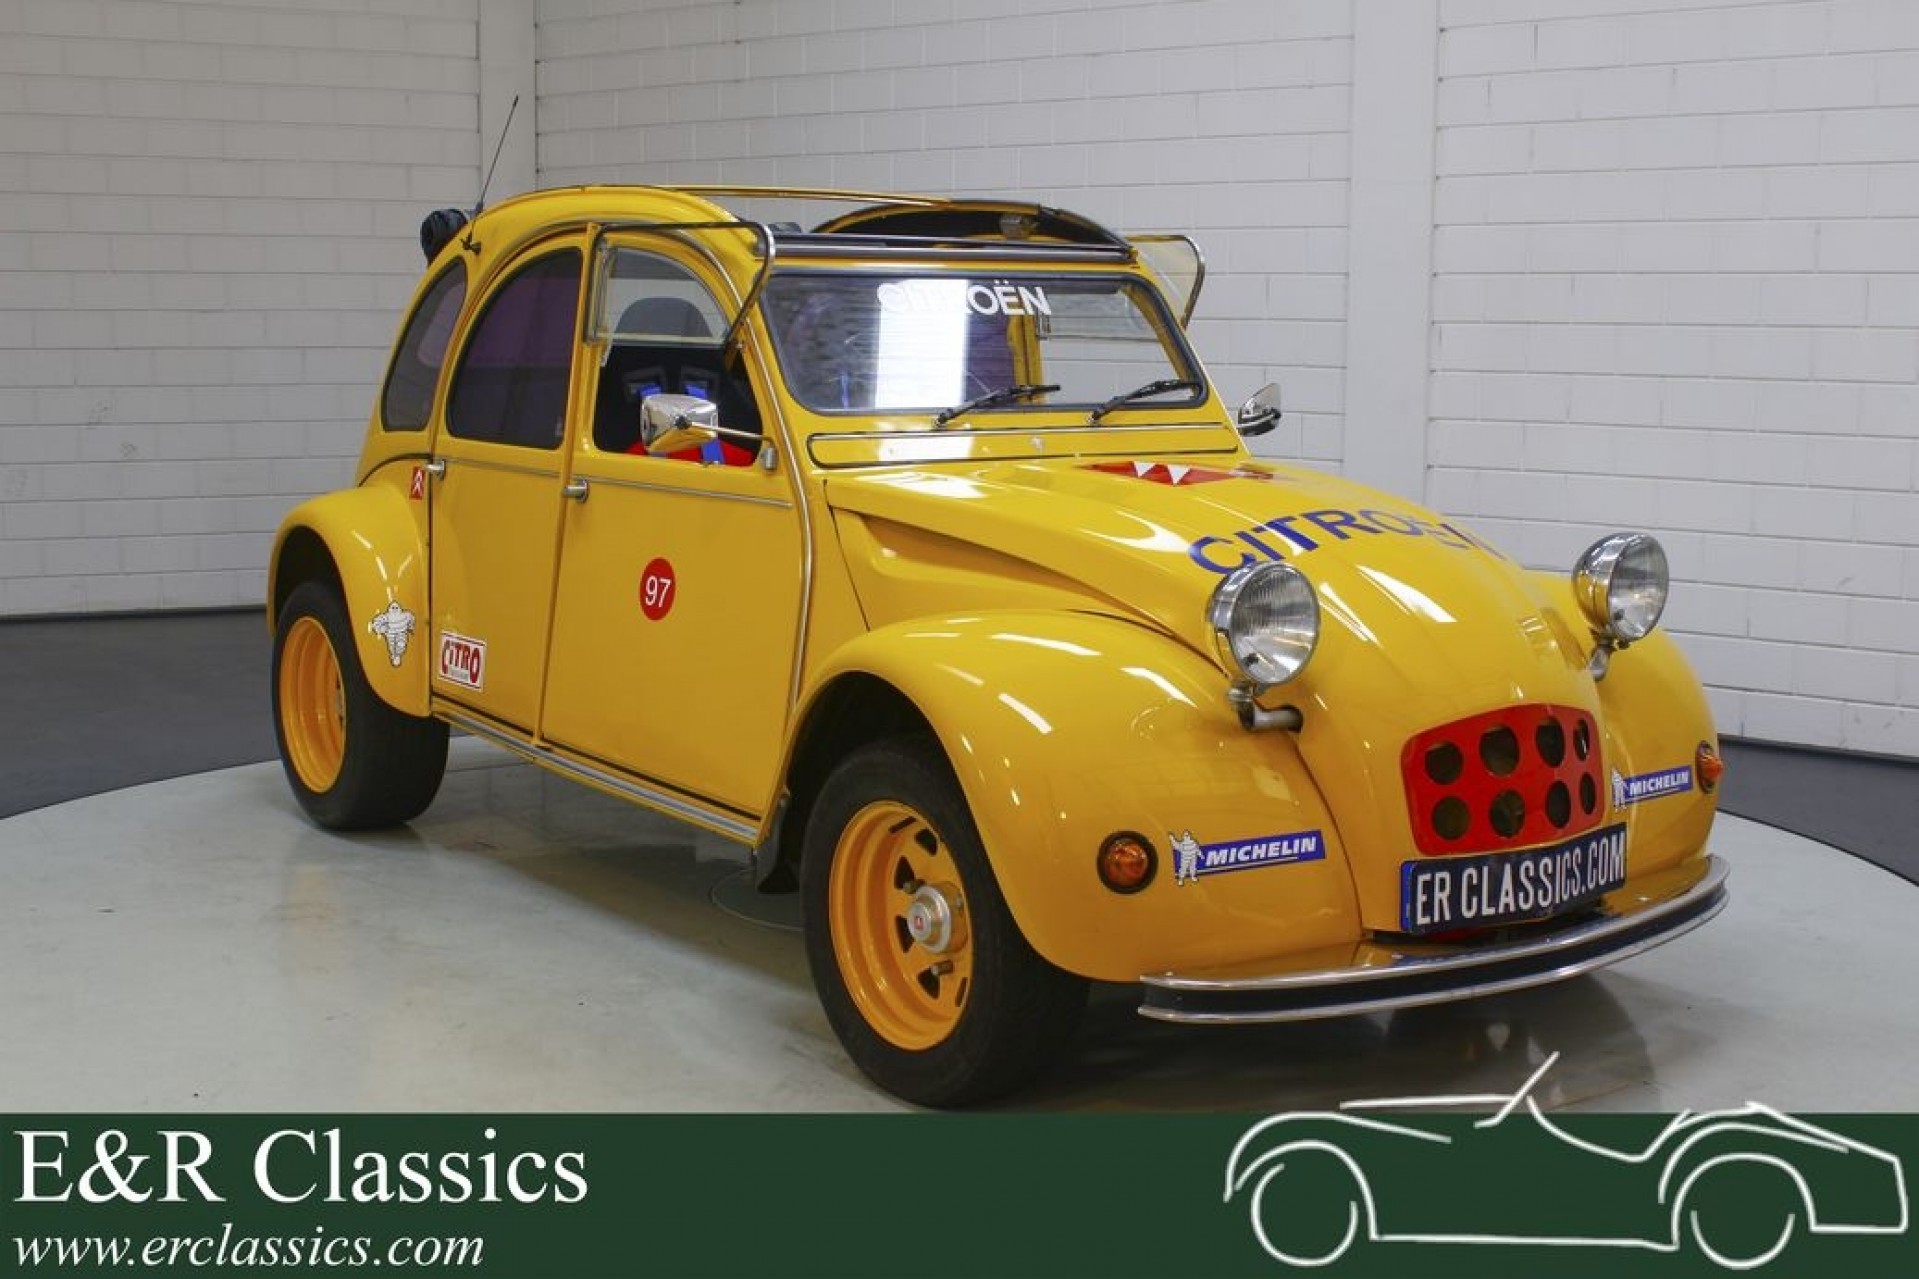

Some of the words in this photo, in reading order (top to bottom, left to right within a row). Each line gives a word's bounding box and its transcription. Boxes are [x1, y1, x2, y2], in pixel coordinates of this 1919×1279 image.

[645, 575, 672, 608] 97
[1629, 770, 1689, 797] MICHELIN
[1205, 836, 1317, 867] MICHELIN
[1416, 871, 1451, 926] ER
[1461, 831, 1626, 919] CLASSICS.COM
